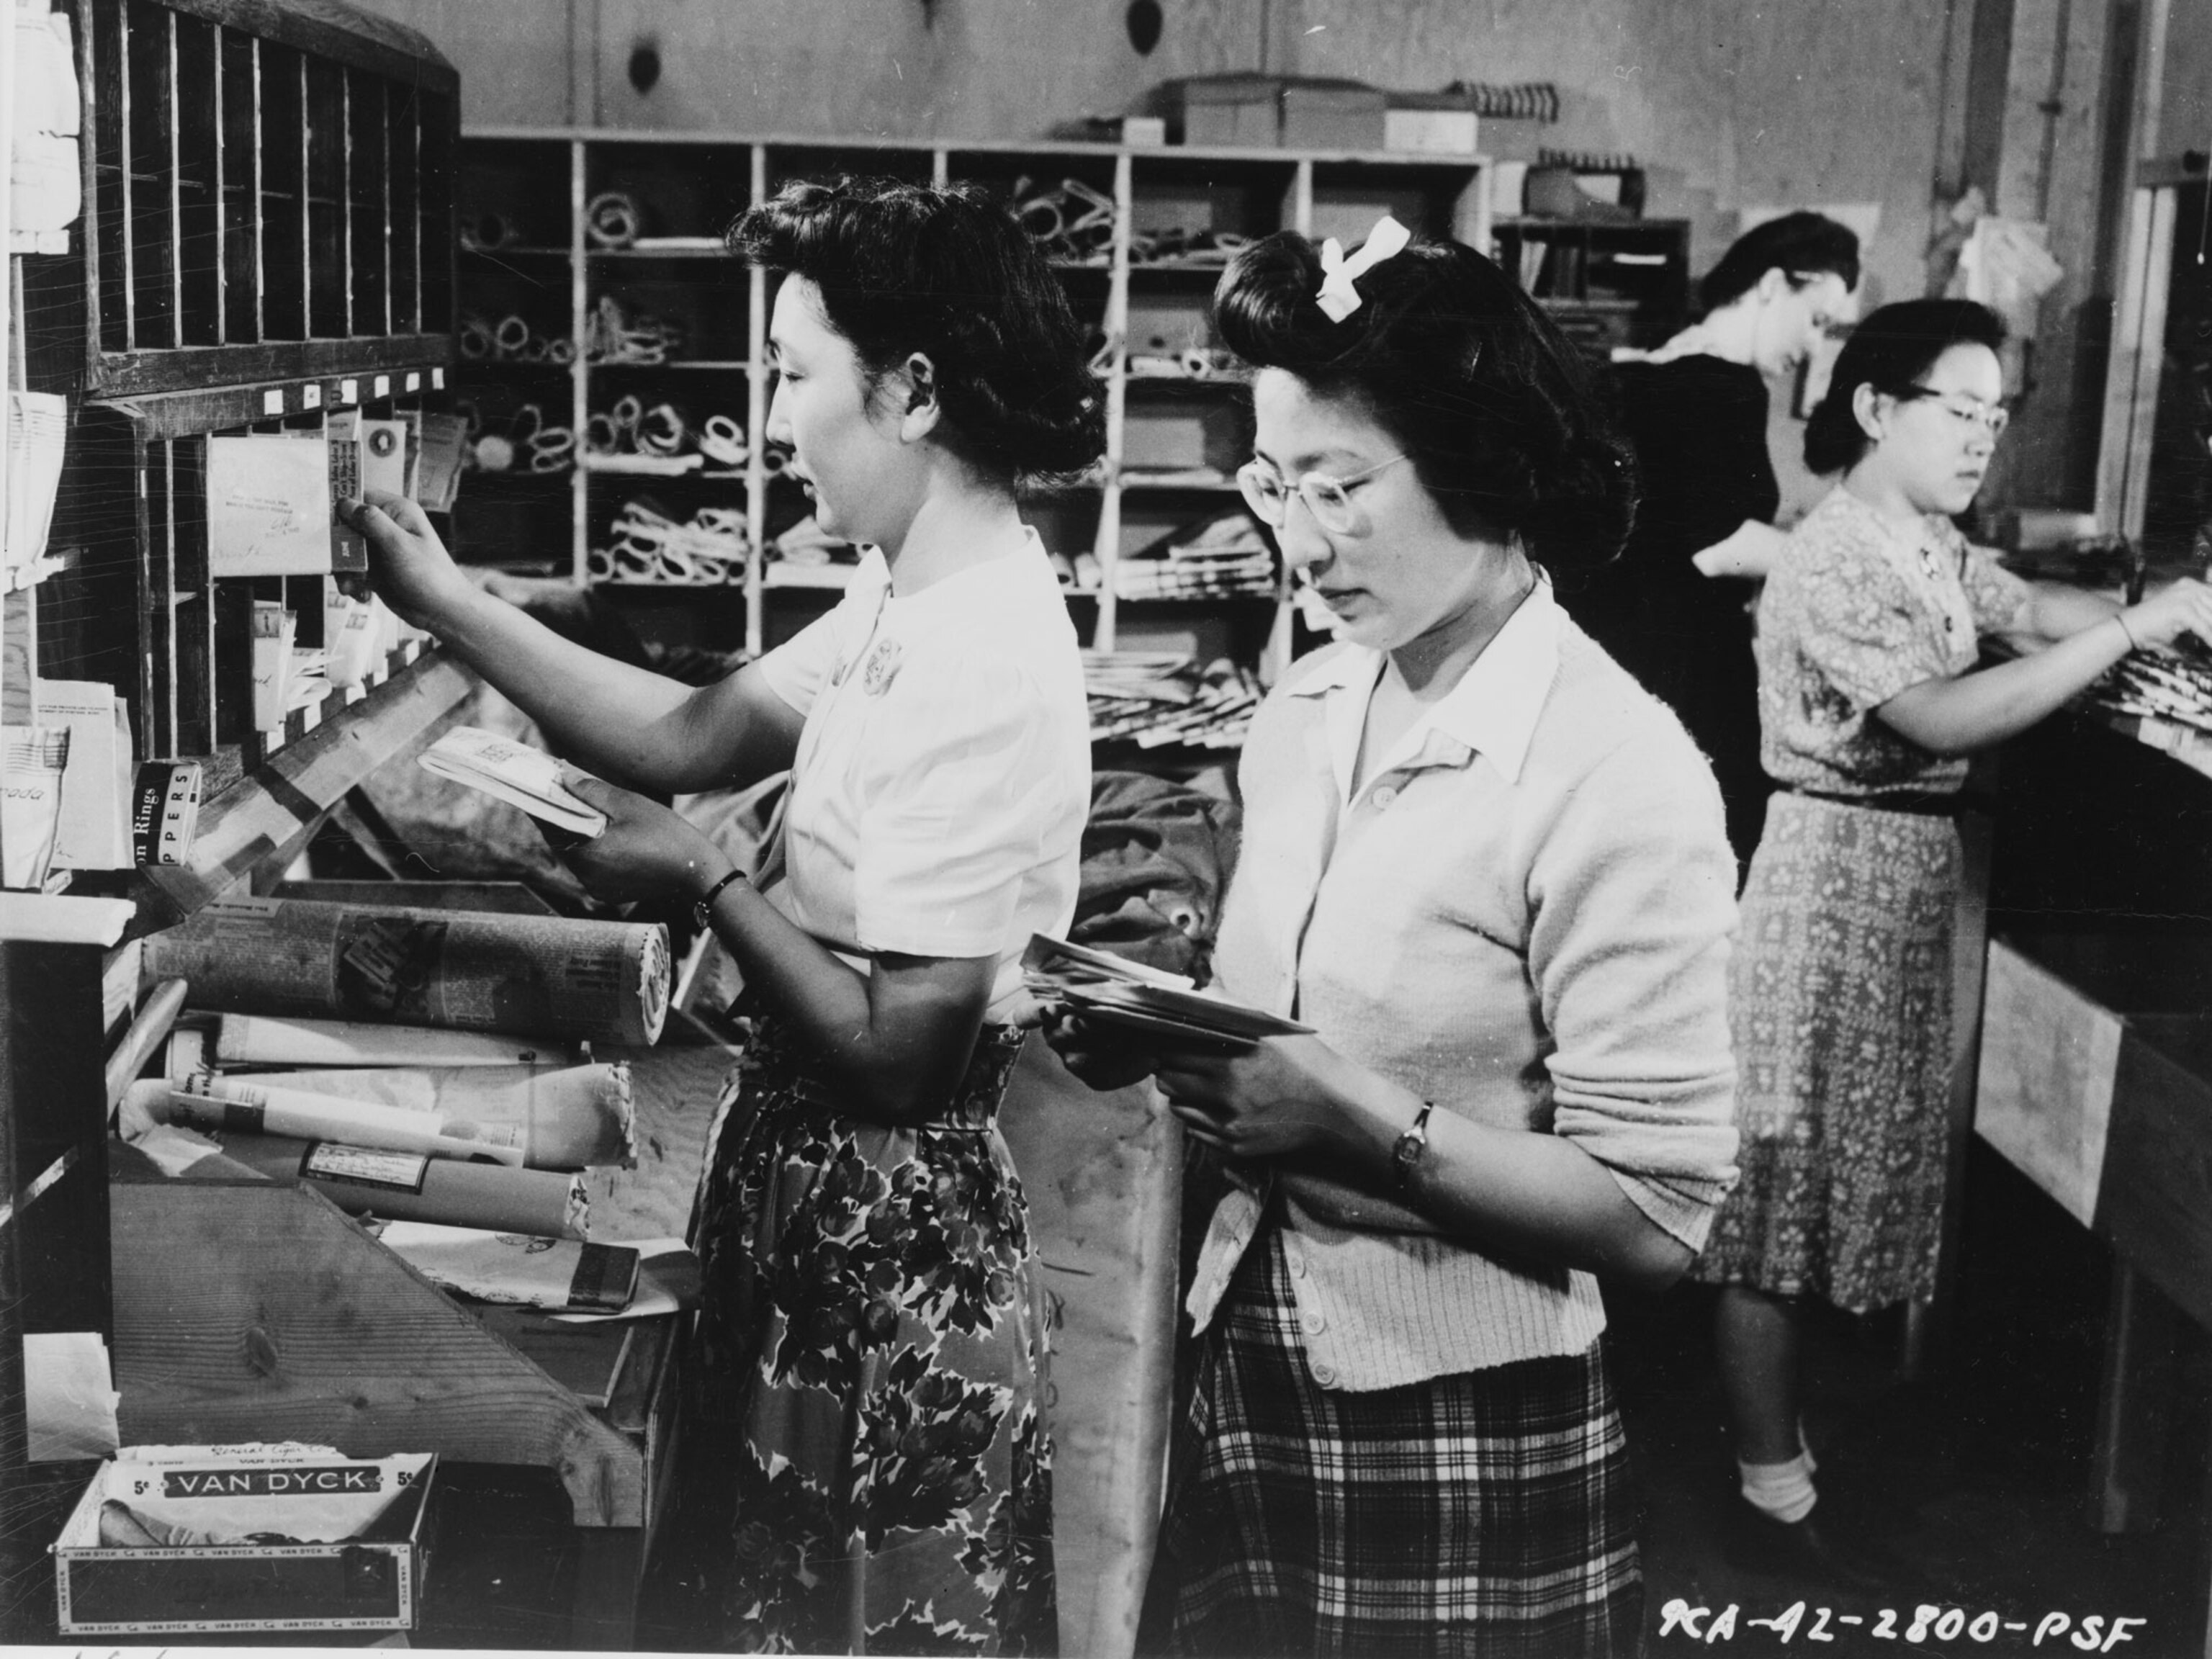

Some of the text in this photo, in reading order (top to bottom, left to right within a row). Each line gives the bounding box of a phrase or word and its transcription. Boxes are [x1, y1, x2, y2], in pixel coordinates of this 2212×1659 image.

[134, 788, 159, 835] Rings
[178, 1471, 366, 1493] VAN DYCK
